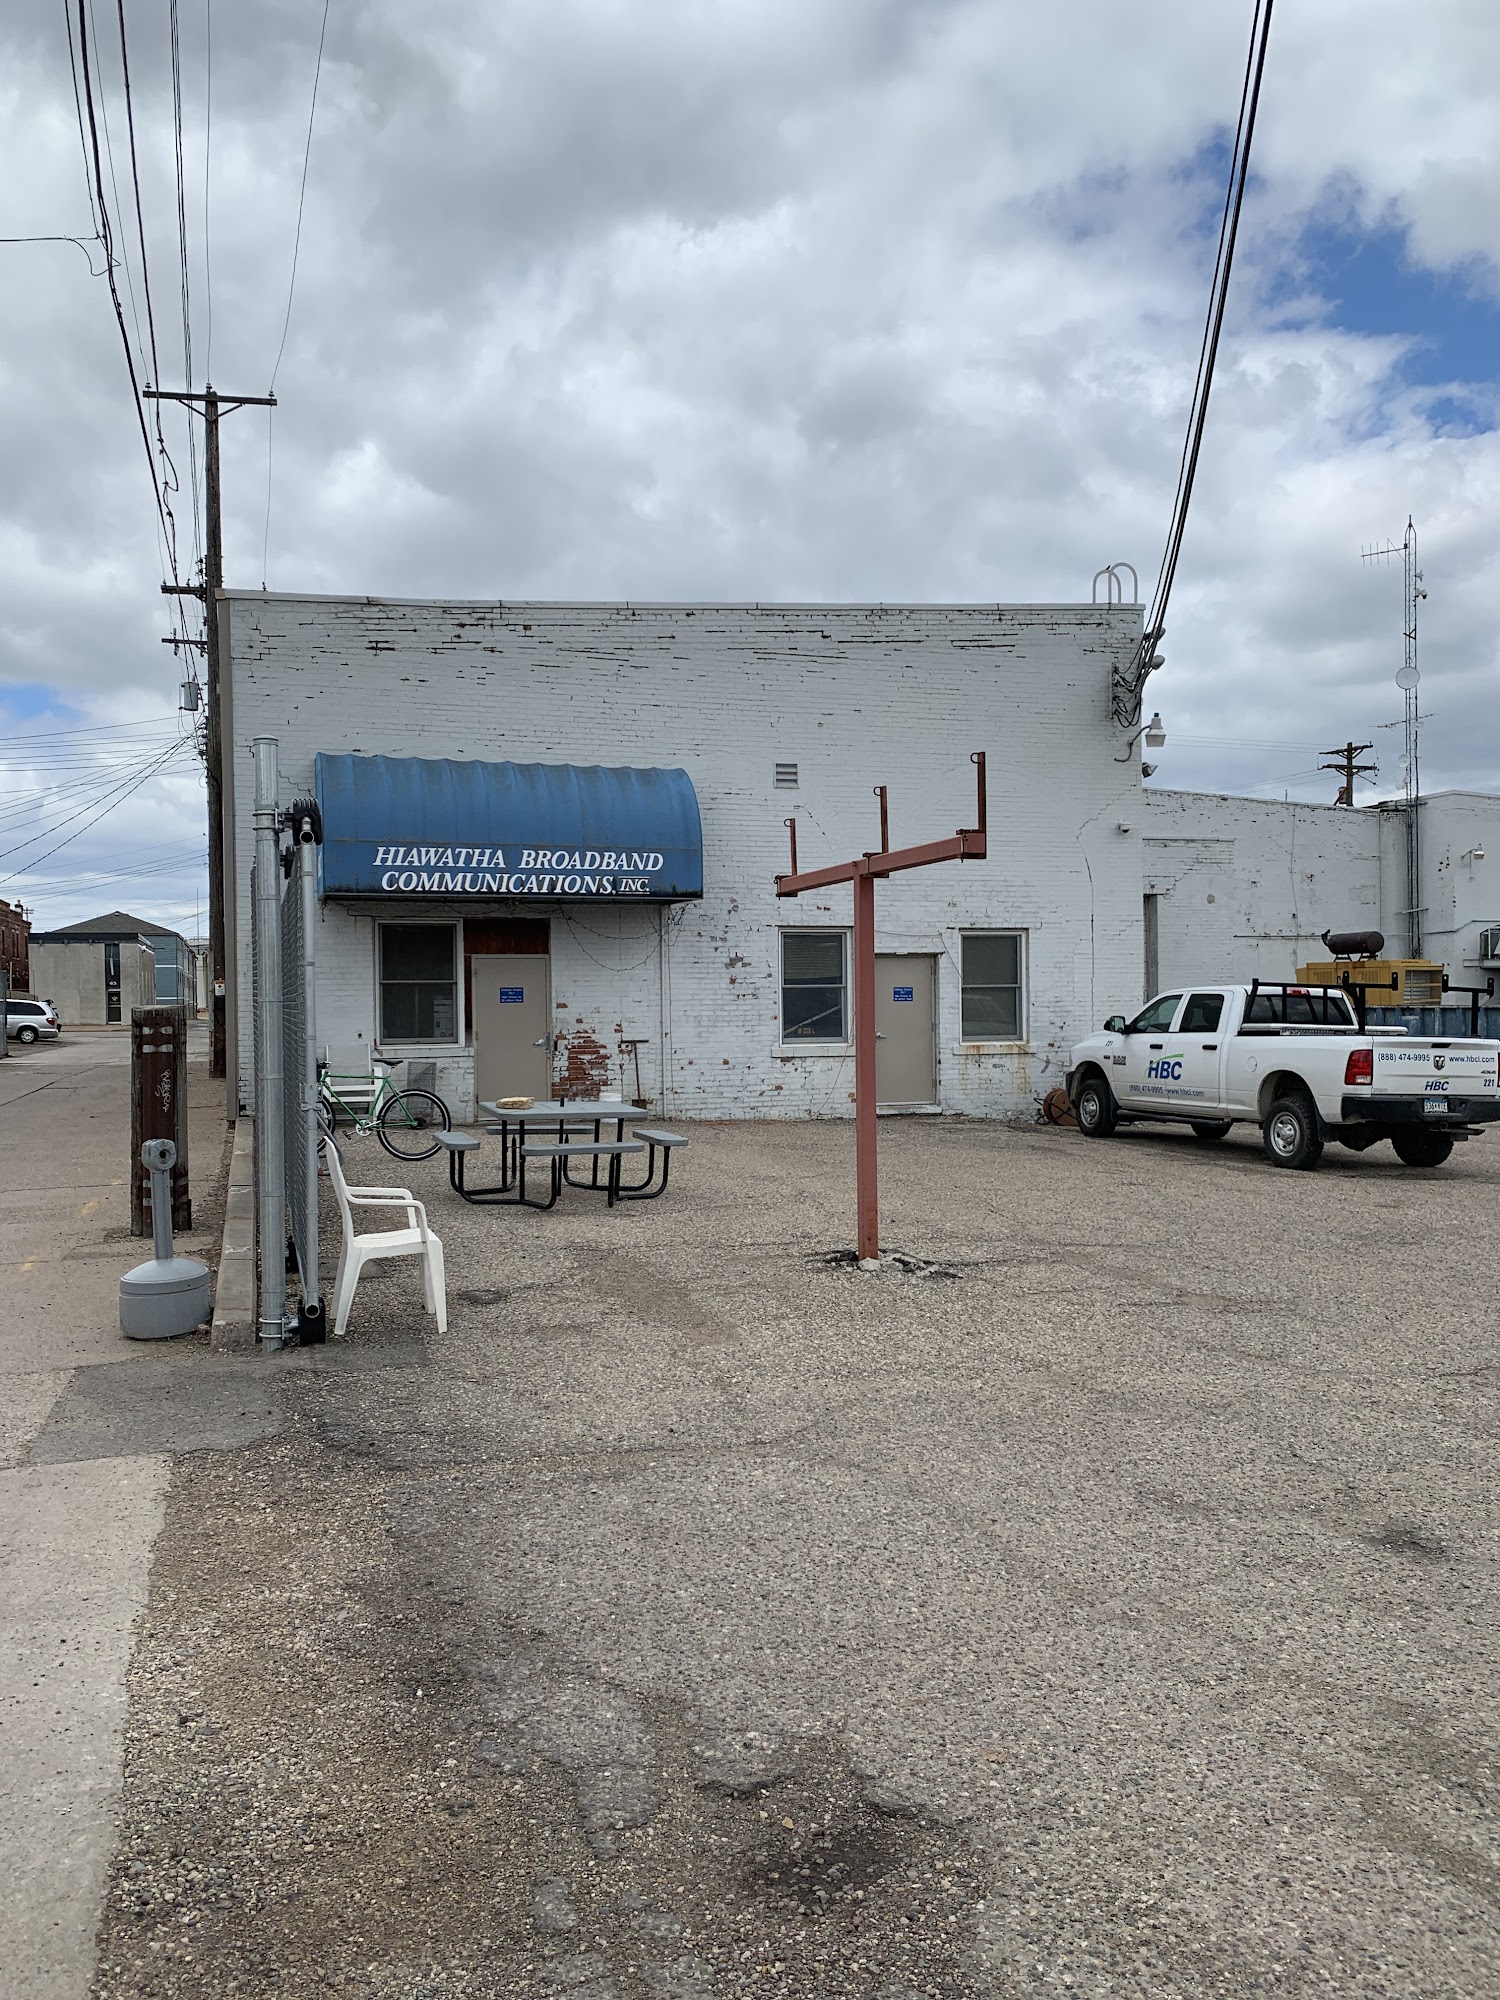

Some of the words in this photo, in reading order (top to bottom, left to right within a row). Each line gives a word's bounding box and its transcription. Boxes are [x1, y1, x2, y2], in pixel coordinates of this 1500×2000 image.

[372, 846, 506, 868] HIAWATHA
[518, 849, 664, 871] BROADBAND
[381, 871, 617, 895] COMMUNICATIONS,
[619, 877, 650, 893] INC.
[1378, 1053, 1397, 1062] (888)
[1398, 1053, 1430, 1062] 474-9995
[1449, 1055, 1495, 1063] www.hbci.com
[1147, 1060, 1183, 1081] HBC
[1424, 1080, 1450, 1091] HBC
[1483, 1079, 1495, 1087] 221
